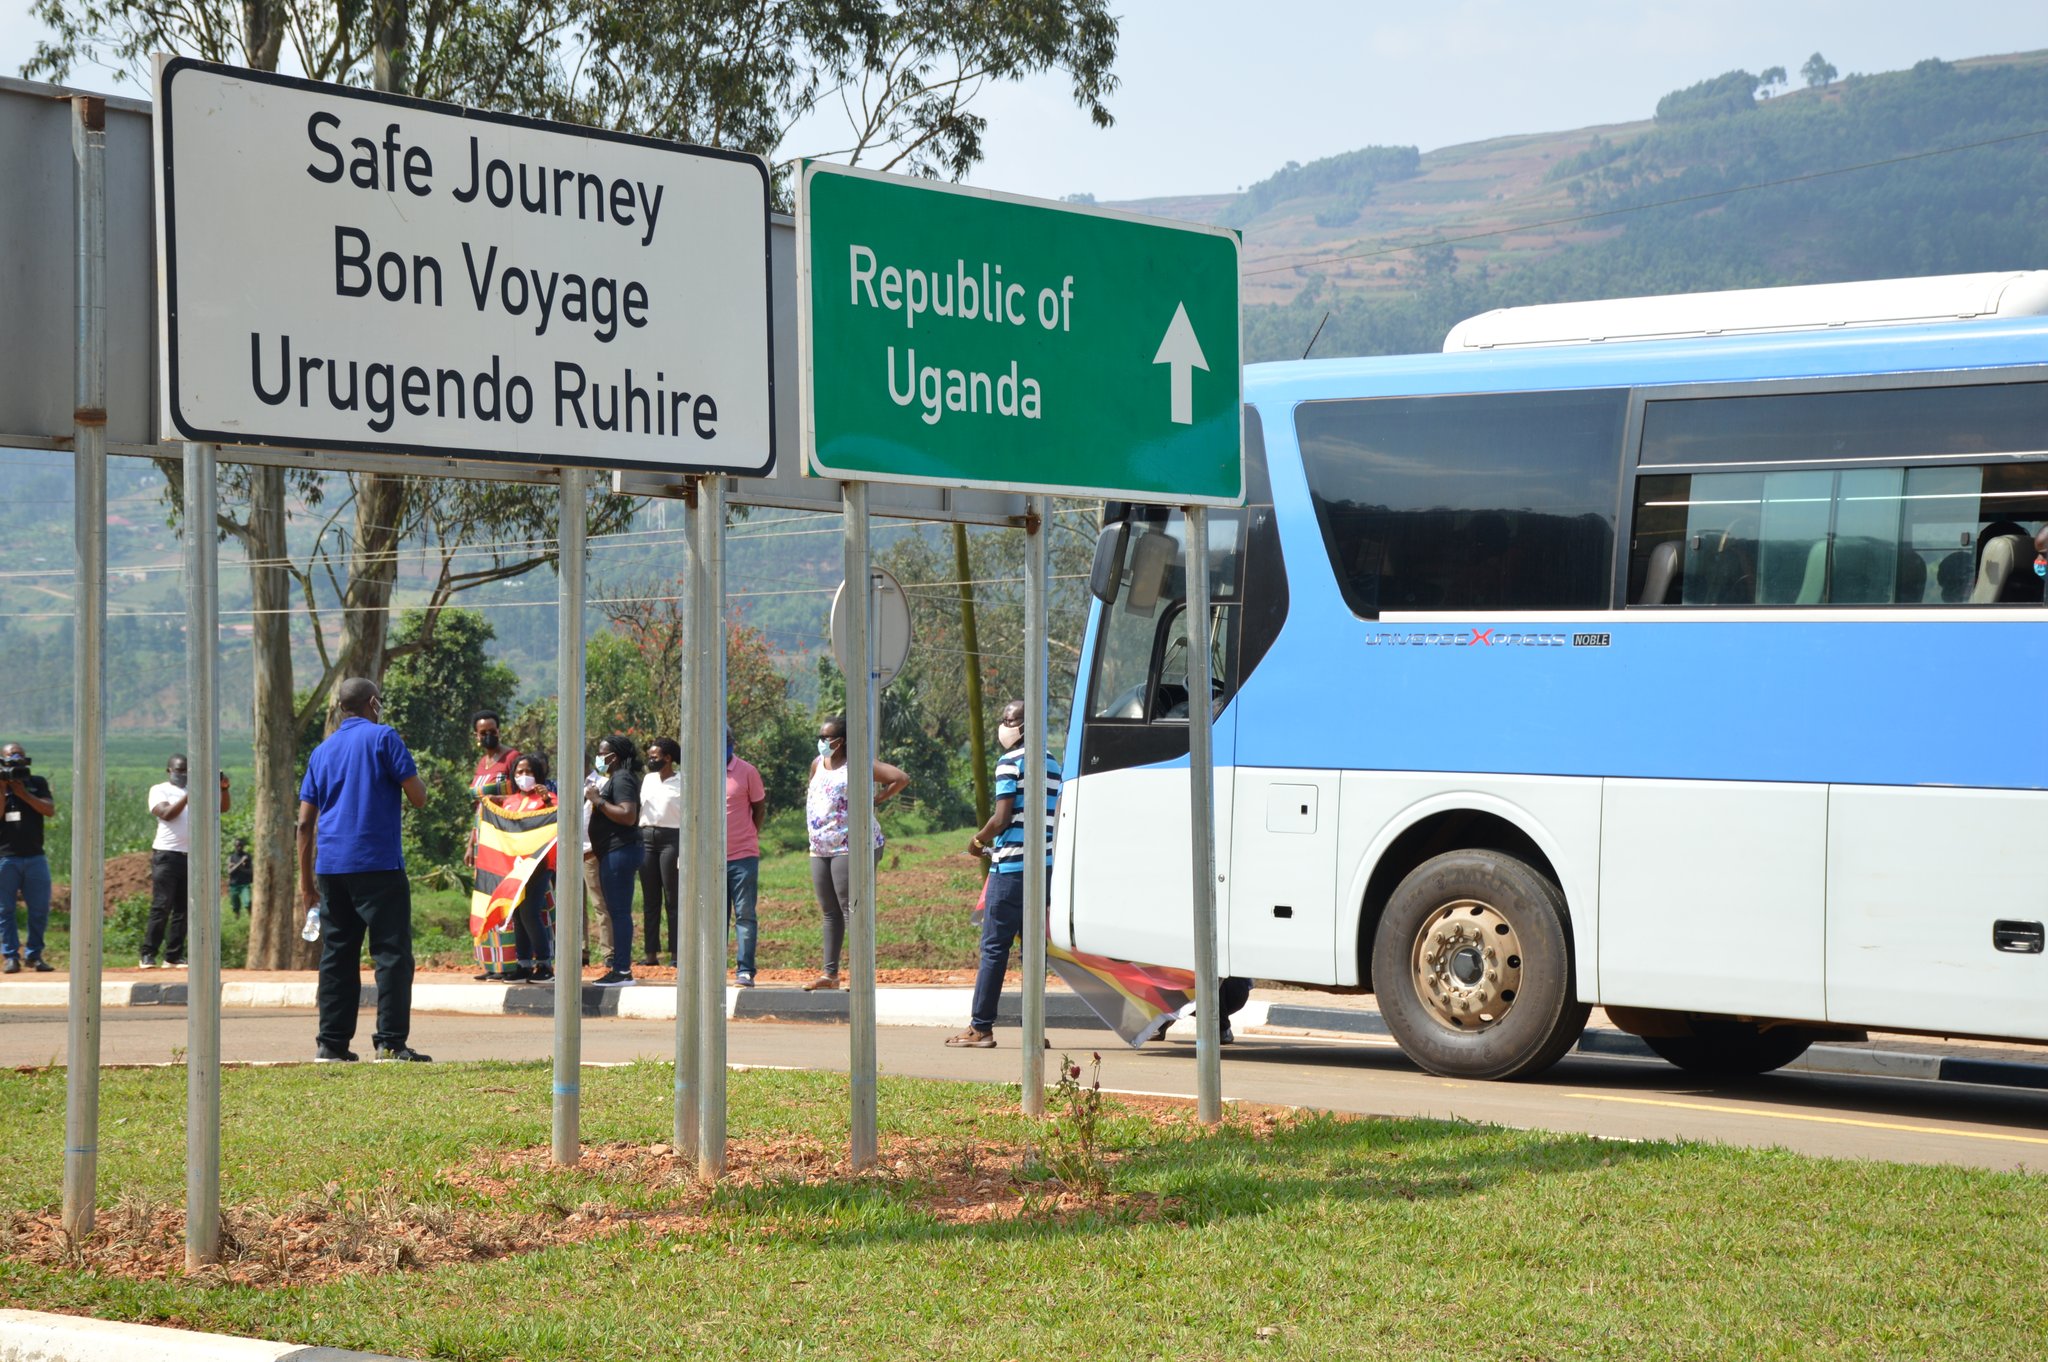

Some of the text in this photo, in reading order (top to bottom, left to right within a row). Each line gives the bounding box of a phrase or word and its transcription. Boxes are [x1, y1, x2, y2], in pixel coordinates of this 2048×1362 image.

[306, 111, 664, 246] Safe Journey
[334, 225, 649, 343] Bon Voyage
[849, 244, 1074, 332] Republic of
[250, 332, 718, 440] Urugendo Ruhire
[887, 346, 1041, 425] Uganda
[1574, 634, 1608, 645] NOBLE
